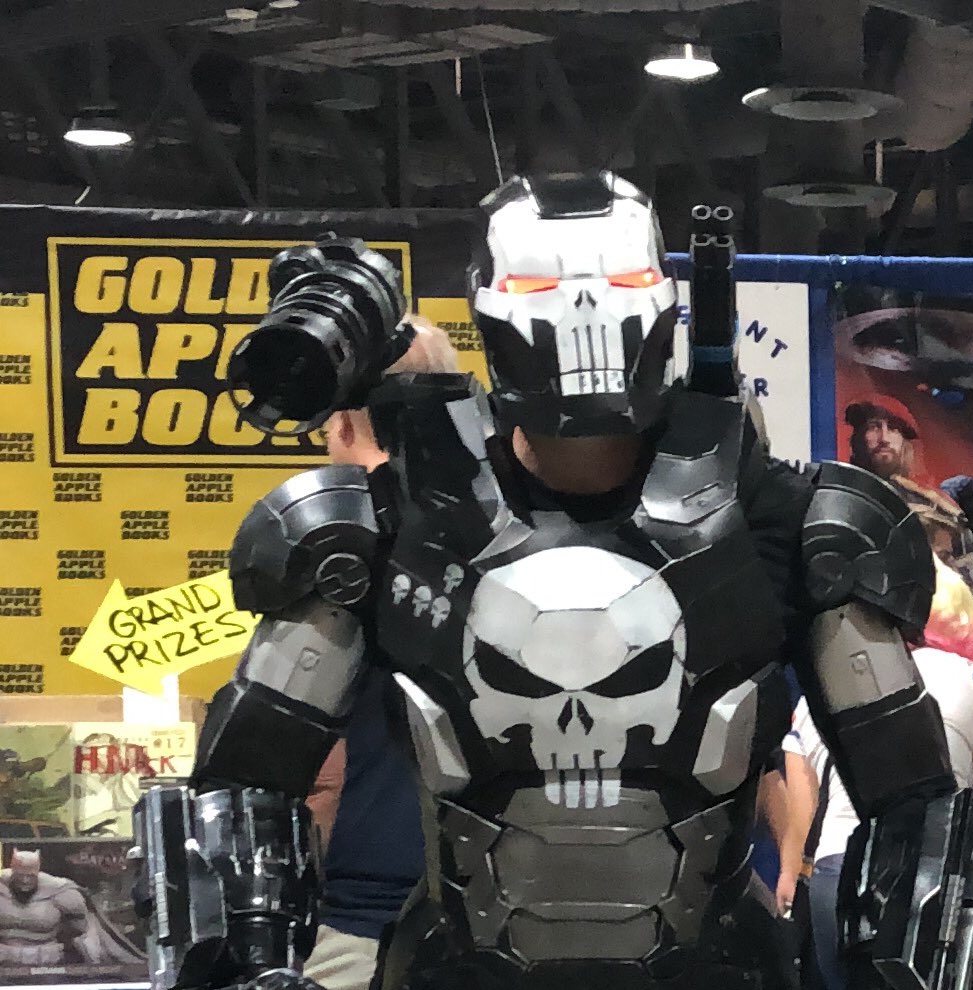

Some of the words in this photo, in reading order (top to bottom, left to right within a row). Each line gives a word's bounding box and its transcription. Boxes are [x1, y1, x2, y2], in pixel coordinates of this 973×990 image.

[74, 256, 270, 315] GOLD
[77, 388, 328, 446] BOO
[0, 443, 34, 452] PPLE
[0, 453, 34, 462] OOKS
[53, 473, 102, 482] GOLDEN
[185, 474, 234, 482] GOLDEN
[54, 483, 102, 492] APPLE
[186, 484, 234, 492] APPLE
[54, 493, 102, 502] BOOKS
[186, 494, 234, 503] BOOKS
[0, 510, 38, 519] OLDEN
[120, 511, 170, 520] GOLDEN
[0, 521, 38, 530] PPLE
[122, 521, 170, 530] APPLE
[0, 531, 38, 540] OOKS
[122, 531, 170, 540] BOOKS
[57, 550, 106, 559] GOLDEN
[188, 550, 231, 558] GOLDE
[58, 560, 106, 569] APPLE
[58, 570, 106, 580] BOOKS
[0, 588, 42, 596] OLDEN
[109, 584, 221, 638] GRAND
[103, 611, 247, 673] PRIZES
